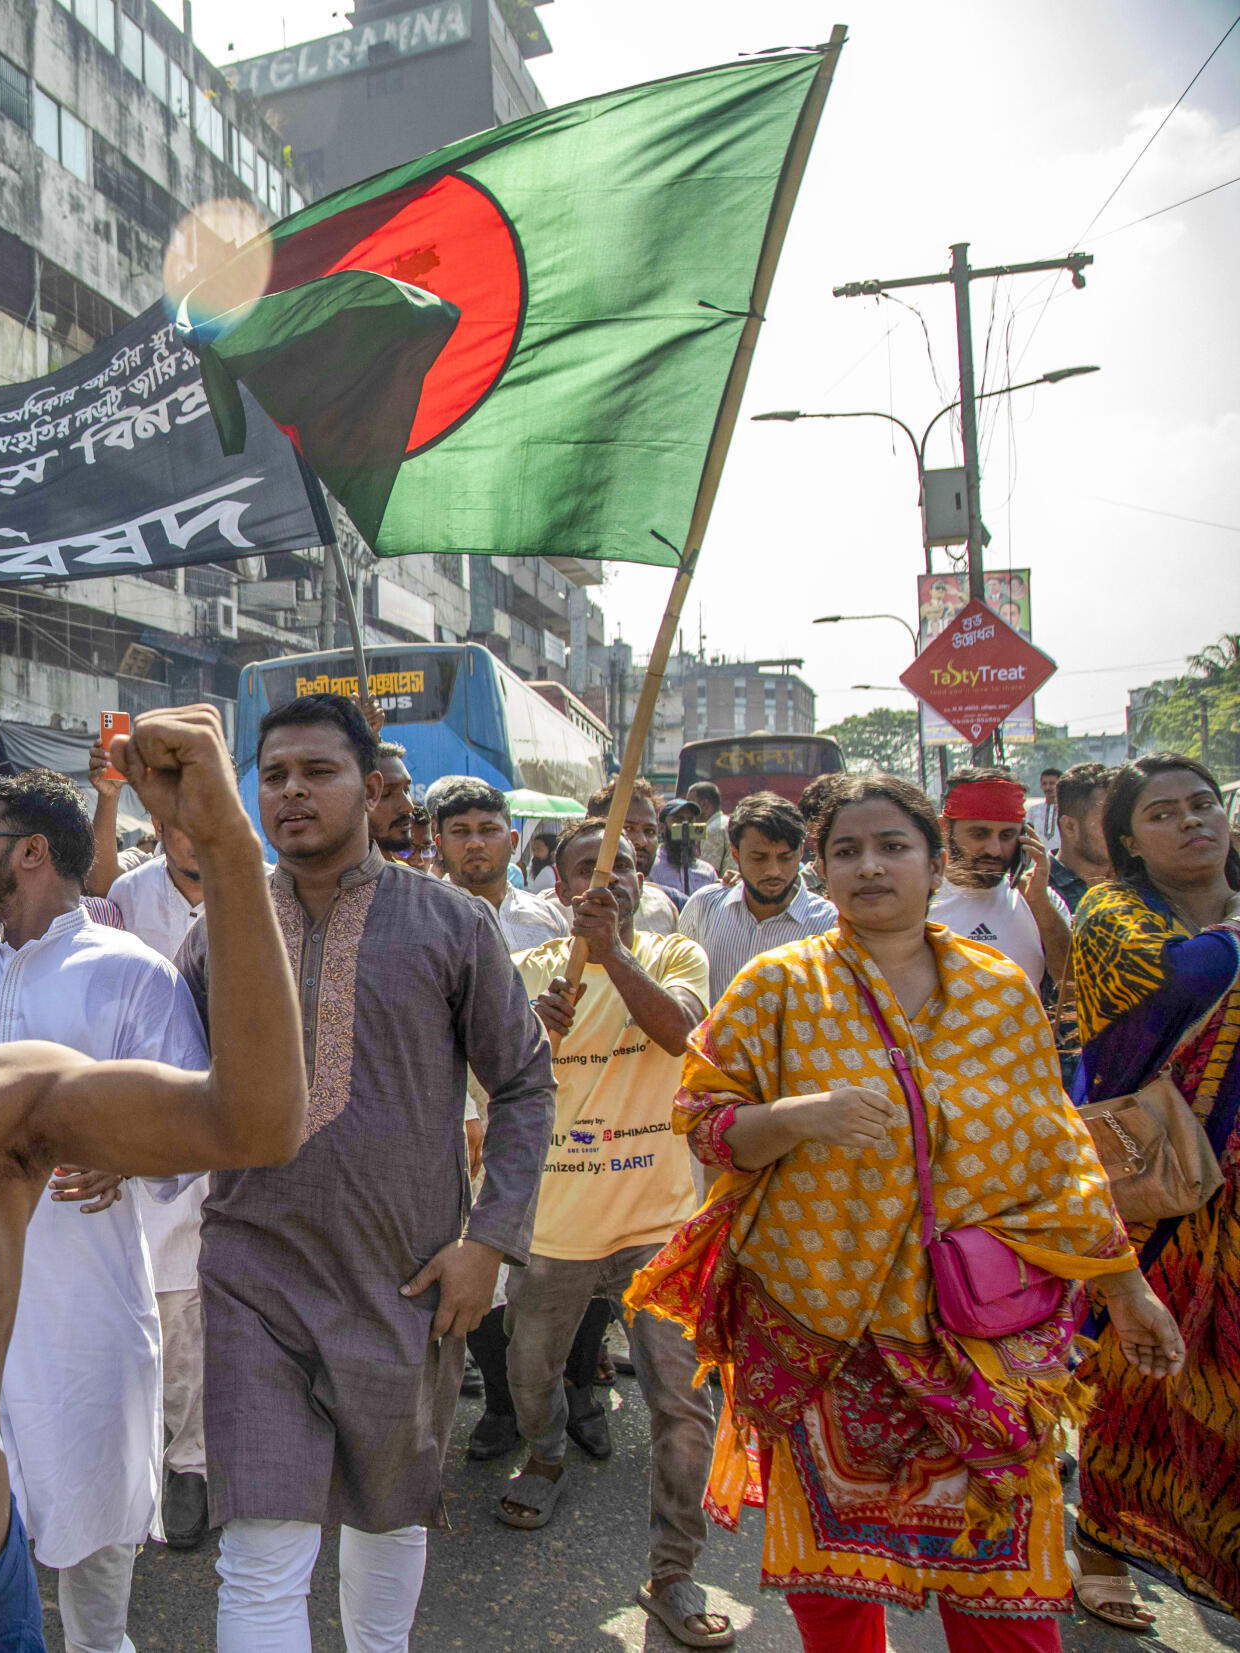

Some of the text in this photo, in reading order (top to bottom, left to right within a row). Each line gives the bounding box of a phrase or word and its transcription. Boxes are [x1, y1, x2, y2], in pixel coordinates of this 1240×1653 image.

[81, 344, 145, 390] জাতীয়
[74, 384, 127, 427] লড়াই
[375, 696, 413, 711] US
[613, 1123, 672, 1139] SHIMADZU
[610, 1154, 655, 1172] BARIT
